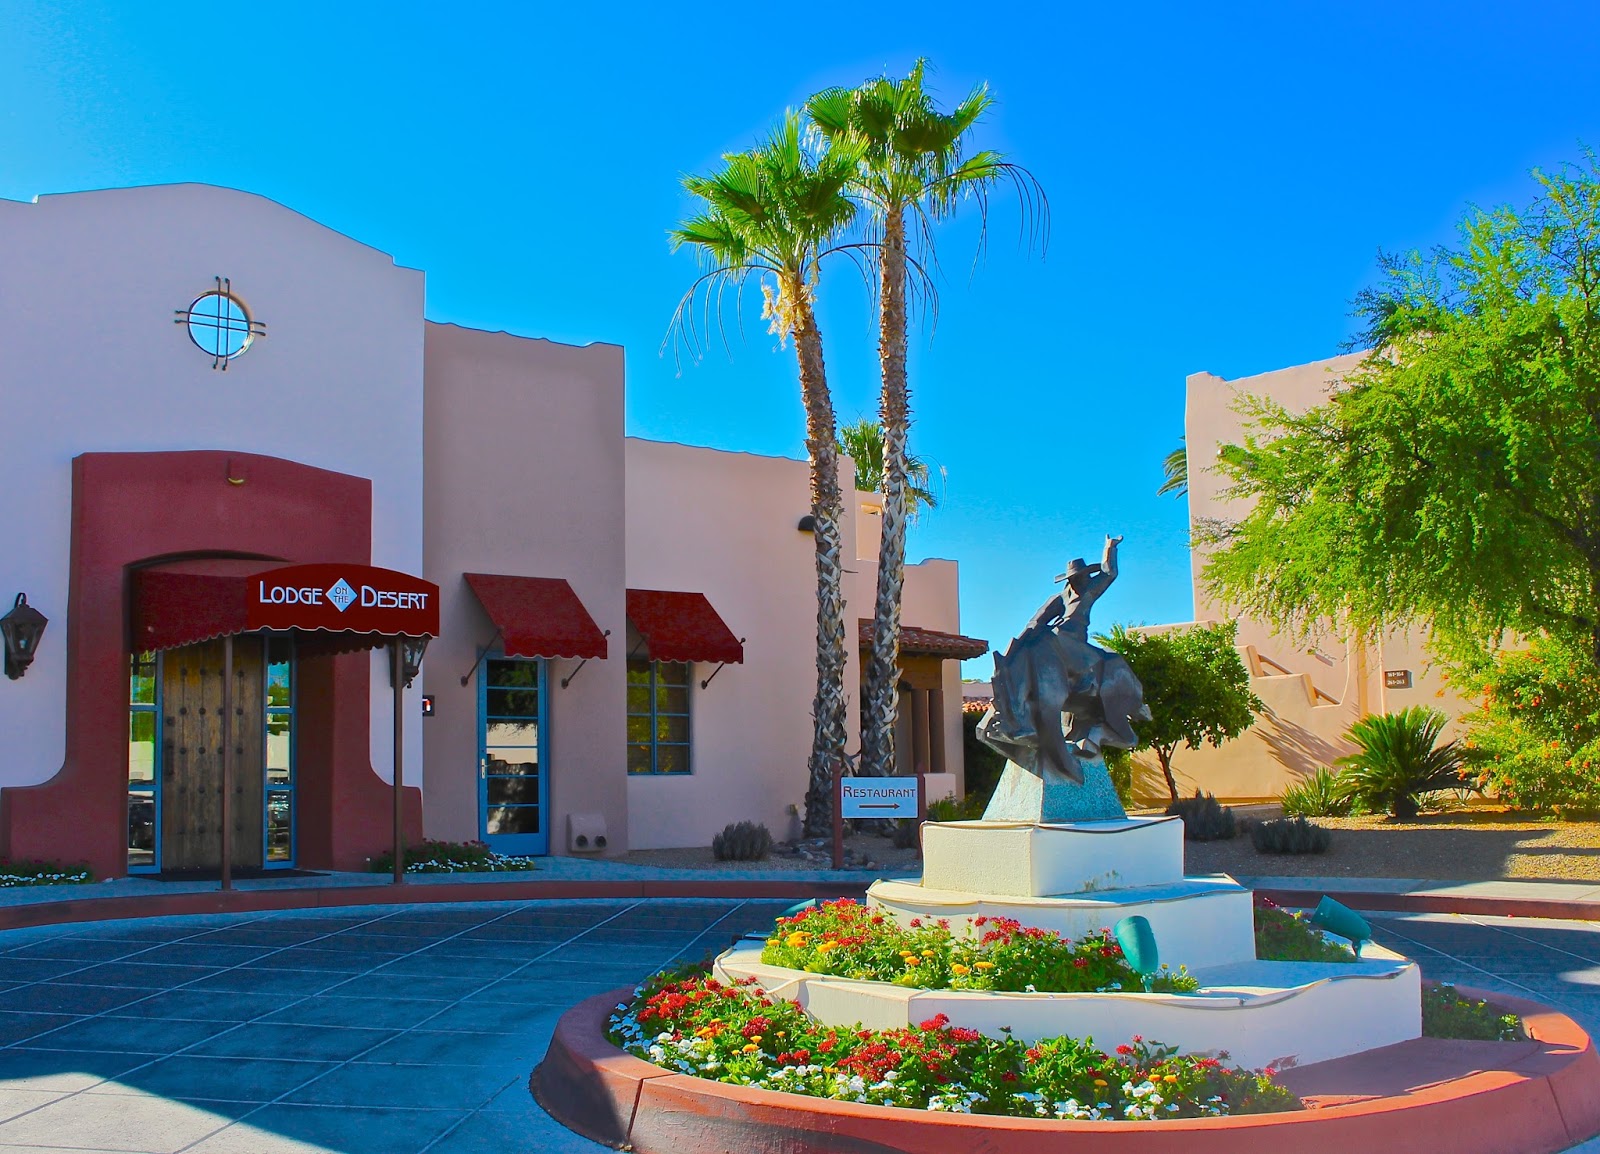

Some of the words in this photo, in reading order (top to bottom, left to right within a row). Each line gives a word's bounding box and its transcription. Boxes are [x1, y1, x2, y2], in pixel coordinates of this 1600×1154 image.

[259, 580, 323, 605] LODGE
[334, 586, 348, 595] ON
[333, 595, 350, 604] THE
[361, 585, 429, 610] DESERT
[843, 786, 916, 798] RESTAURANT
